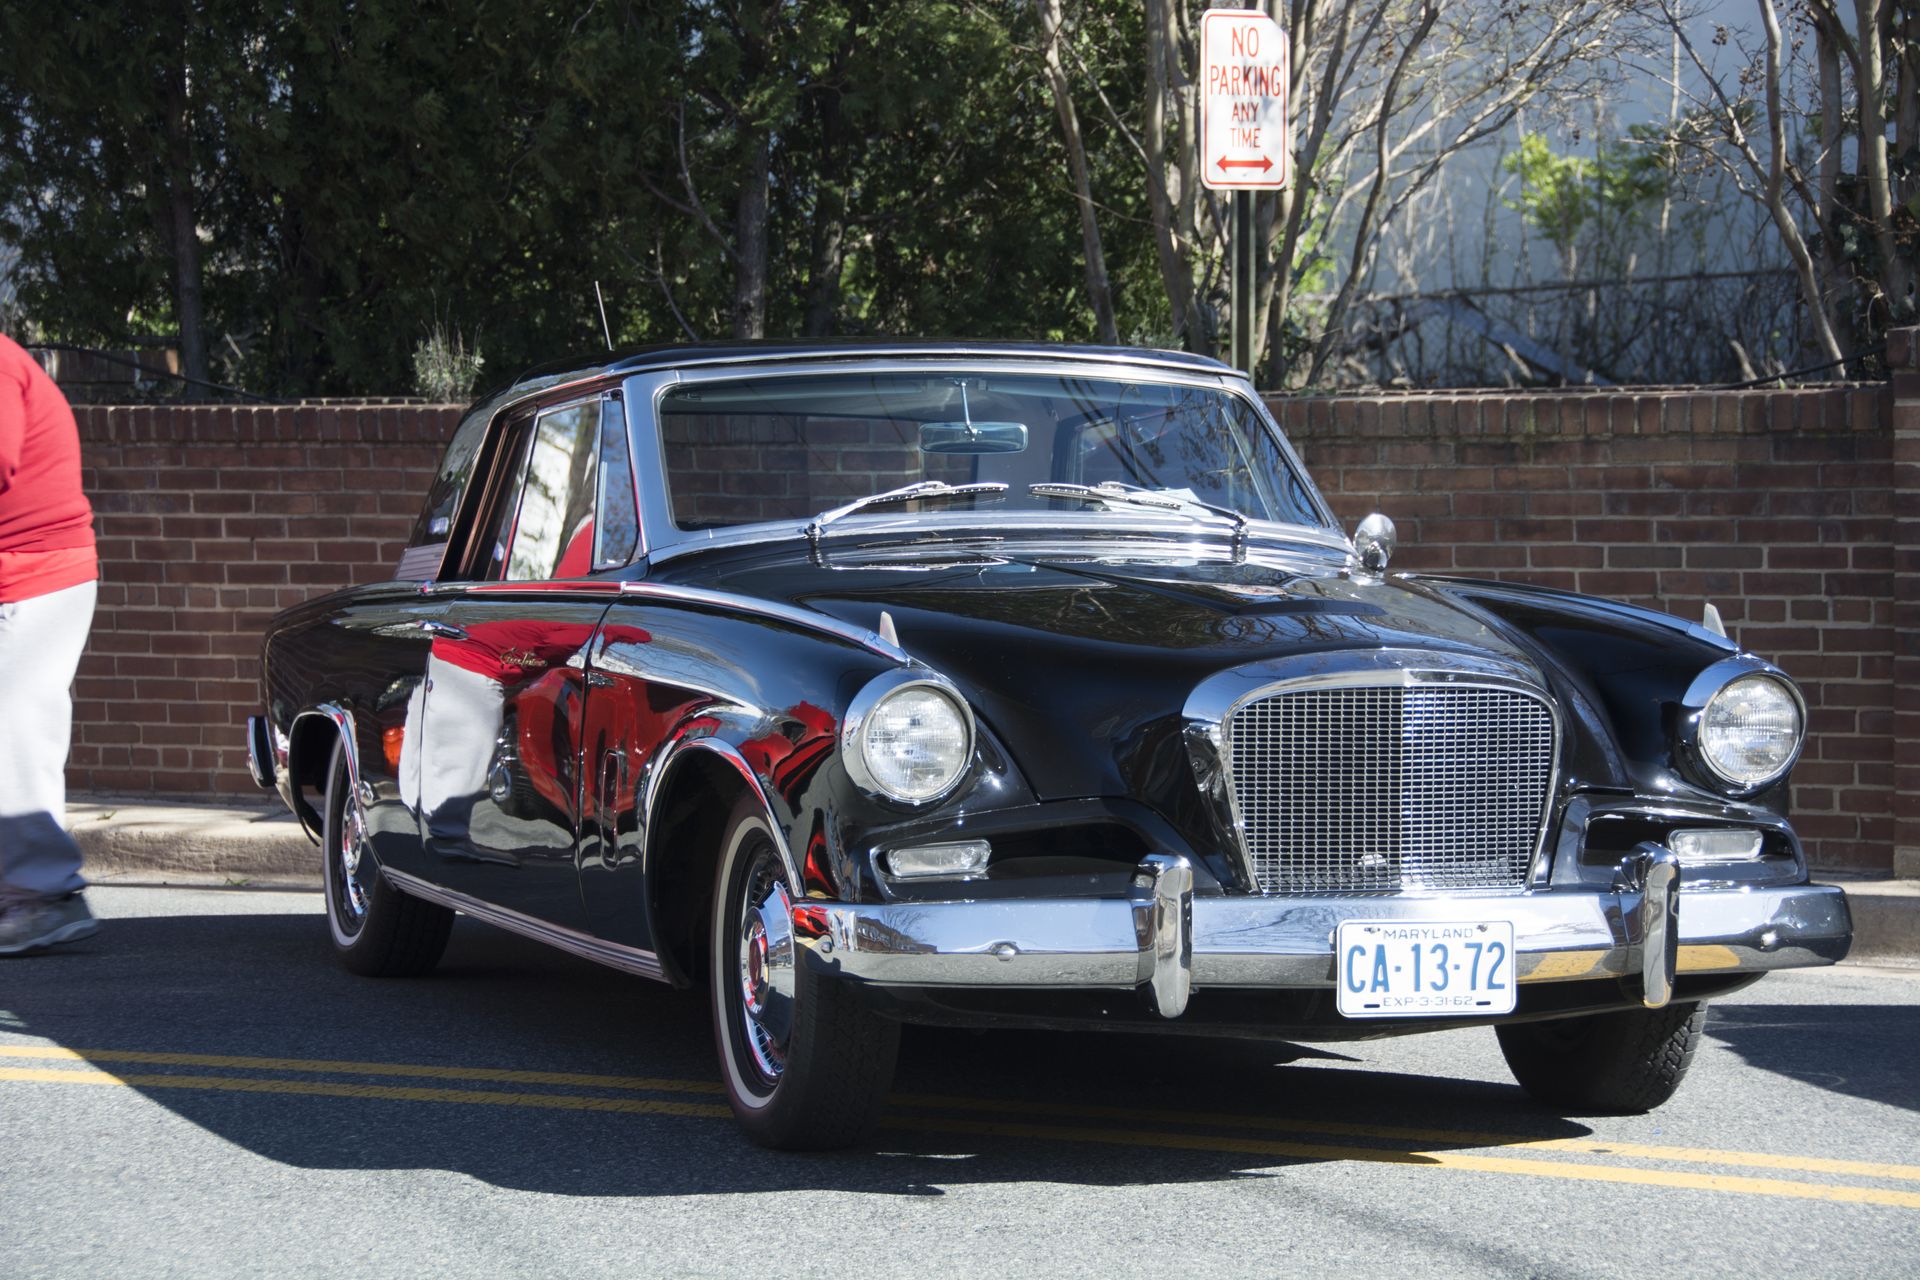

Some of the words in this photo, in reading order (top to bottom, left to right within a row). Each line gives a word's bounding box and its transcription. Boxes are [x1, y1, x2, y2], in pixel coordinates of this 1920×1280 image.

[1232, 27, 1259, 57] NO
[1210, 65, 1280, 96] PARKING
[1232, 102, 1259, 122] ANY
[1229, 128, 1261, 148] TIME
[1383, 928, 1473, 940] MARYLAND
